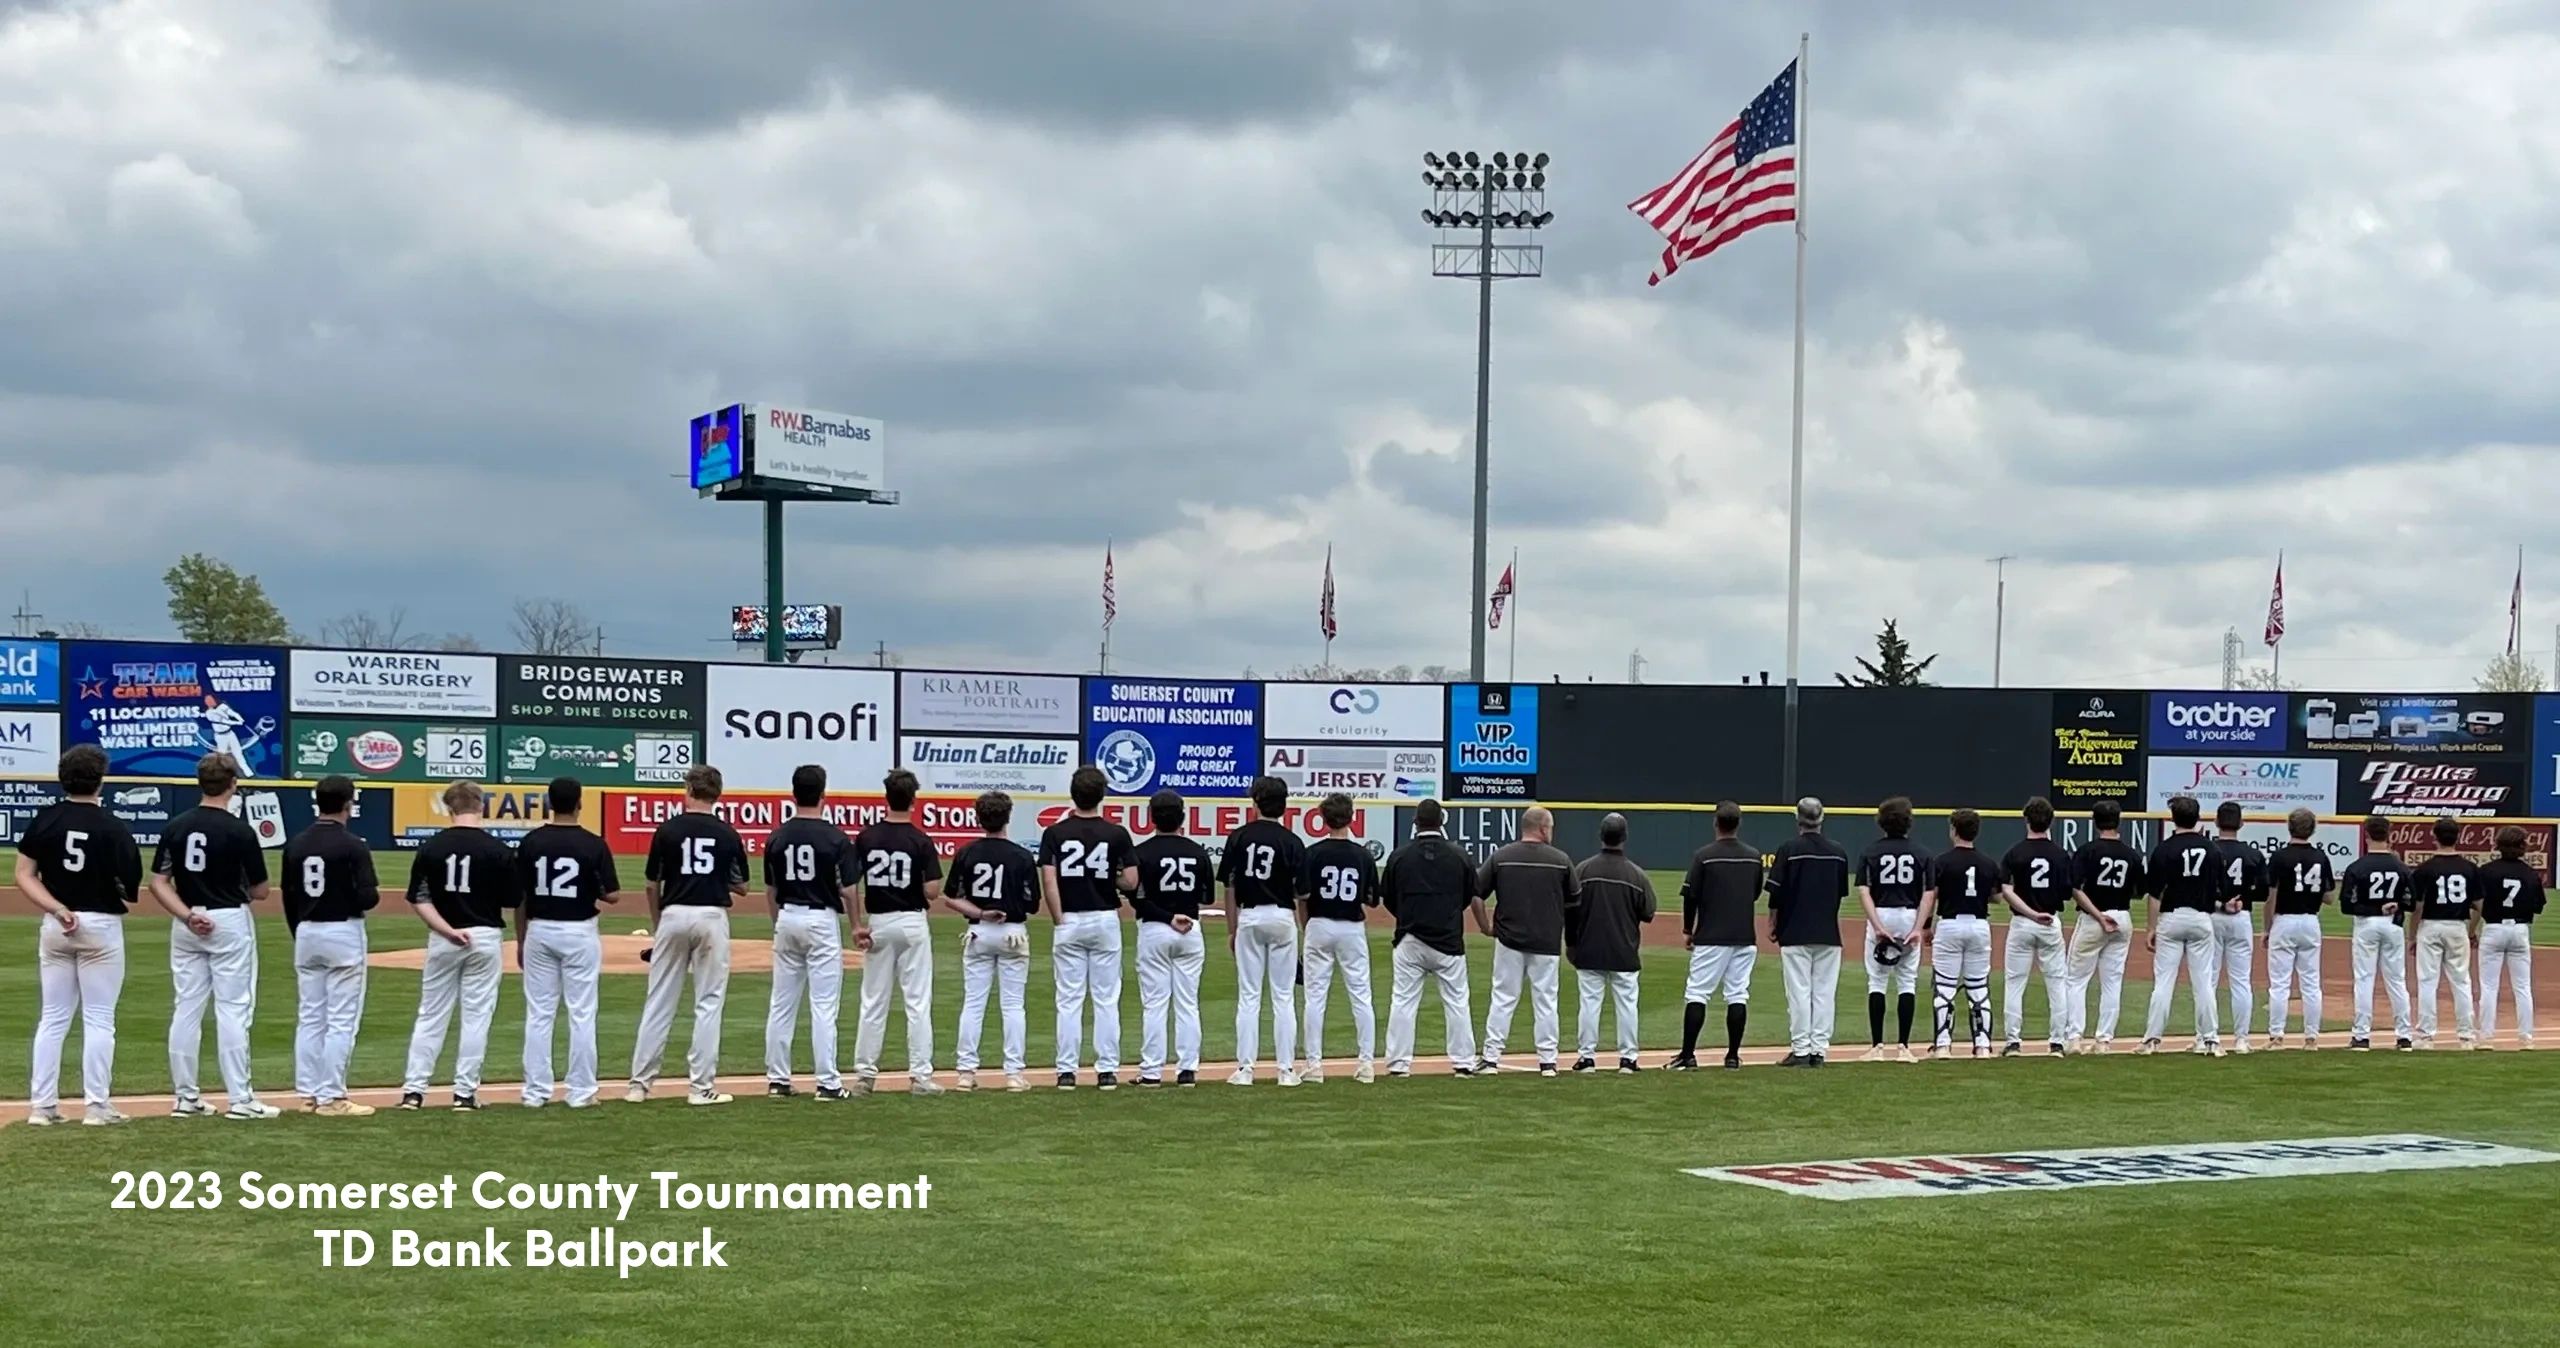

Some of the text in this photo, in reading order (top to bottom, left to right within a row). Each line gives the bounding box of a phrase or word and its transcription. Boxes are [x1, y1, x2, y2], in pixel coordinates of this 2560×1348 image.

[771, 409, 871, 441] RWJBarnabas
[784, 431, 826, 447] HEALTH
[206, 666, 276, 677] WINNERS
[348, 655, 440, 671] WARREN
[113, 662, 197, 686] TEAM
[315, 670, 472, 688] ORAL SURGERY
[520, 664, 684, 686] BRIDGEWATER
[113, 685, 202, 698] CAR WASH
[211, 678, 272, 692] WASH!
[542, 685, 662, 703] COMMONS
[923, 678, 1023, 695] KRAMER
[1111, 684, 1235, 704] SOMERSET COUNTY
[964, 696, 1060, 710] PORTRAITS
[2402, 698, 2458, 708] brother.com
[90, 708, 106, 720] 11
[725, 702, 877, 741] sanofi
[1093, 705, 1254, 726] EDUCATION ASSOCIATION
[2078, 710, 2116, 718] ACURA
[2167, 701, 2277, 728] brother
[98, 722, 199, 736] 1 UNLIMITED
[1319, 725, 1389, 737] celularity
[1475, 722, 1514, 745] VIP
[2185, 729, 2256, 743] at your side
[99, 734, 199, 748] WASH CLUB.
[449, 738, 483, 760] 26
[1179, 744, 1234, 758] PROUD OF
[2059, 736, 2139, 752] Bridgewater
[657, 744, 690, 765] 28
[912, 741, 1068, 765] Union Catholic
[1270, 749, 1304, 767] AJ
[1461, 742, 1528, 767] Honda
[2067, 746, 2124, 765] Acura
[429, 765, 485, 776] MILLION
[983, 770, 1026, 781] SCHOOL
[1176, 760, 1237, 773] OUR GREAT
[2360, 761, 2478, 782] Hicks
[1159, 774, 1197, 787] PUBLIC
[1305, 772, 1386, 788] JERSEY
[2371, 780, 2506, 801] Paving
[250, 802, 278, 820] Lite
[625, 796, 772, 824] FLEMGTON
[922, 802, 982, 828] STOR
[2371, 805, 2497, 818] HicksPaving.com
[2388, 824, 2424, 845] oble
[62, 830, 89, 872] 5
[184, 832, 207, 872] 6
[681, 837, 716, 875] 15
[1060, 840, 1109, 879] 24
[2327, 842, 2353, 856] Co.
[784, 844, 816, 881] 19
[866, 850, 912, 889] 20
[1245, 842, 1275, 880] 13
[1879, 854, 1915, 885] 26
[2182, 847, 2206, 877] 17
[2227, 857, 2243, 886] 4
[302, 855, 325, 897] 8
[445, 853, 472, 893] 11
[535, 856, 580, 898] 12
[972, 862, 1004, 899] 21
[1159, 857, 1197, 892] 25
[1965, 866, 1977, 897] 1
[2030, 857, 2050, 888] 2
[2096, 856, 2129, 888] 23
[2293, 863, 2322, 892] 14
[1319, 865, 1360, 901] 36
[2369, 871, 2400, 900] 27
[2436, 874, 2467, 905] 18
[2502, 878, 2522, 907] 7
